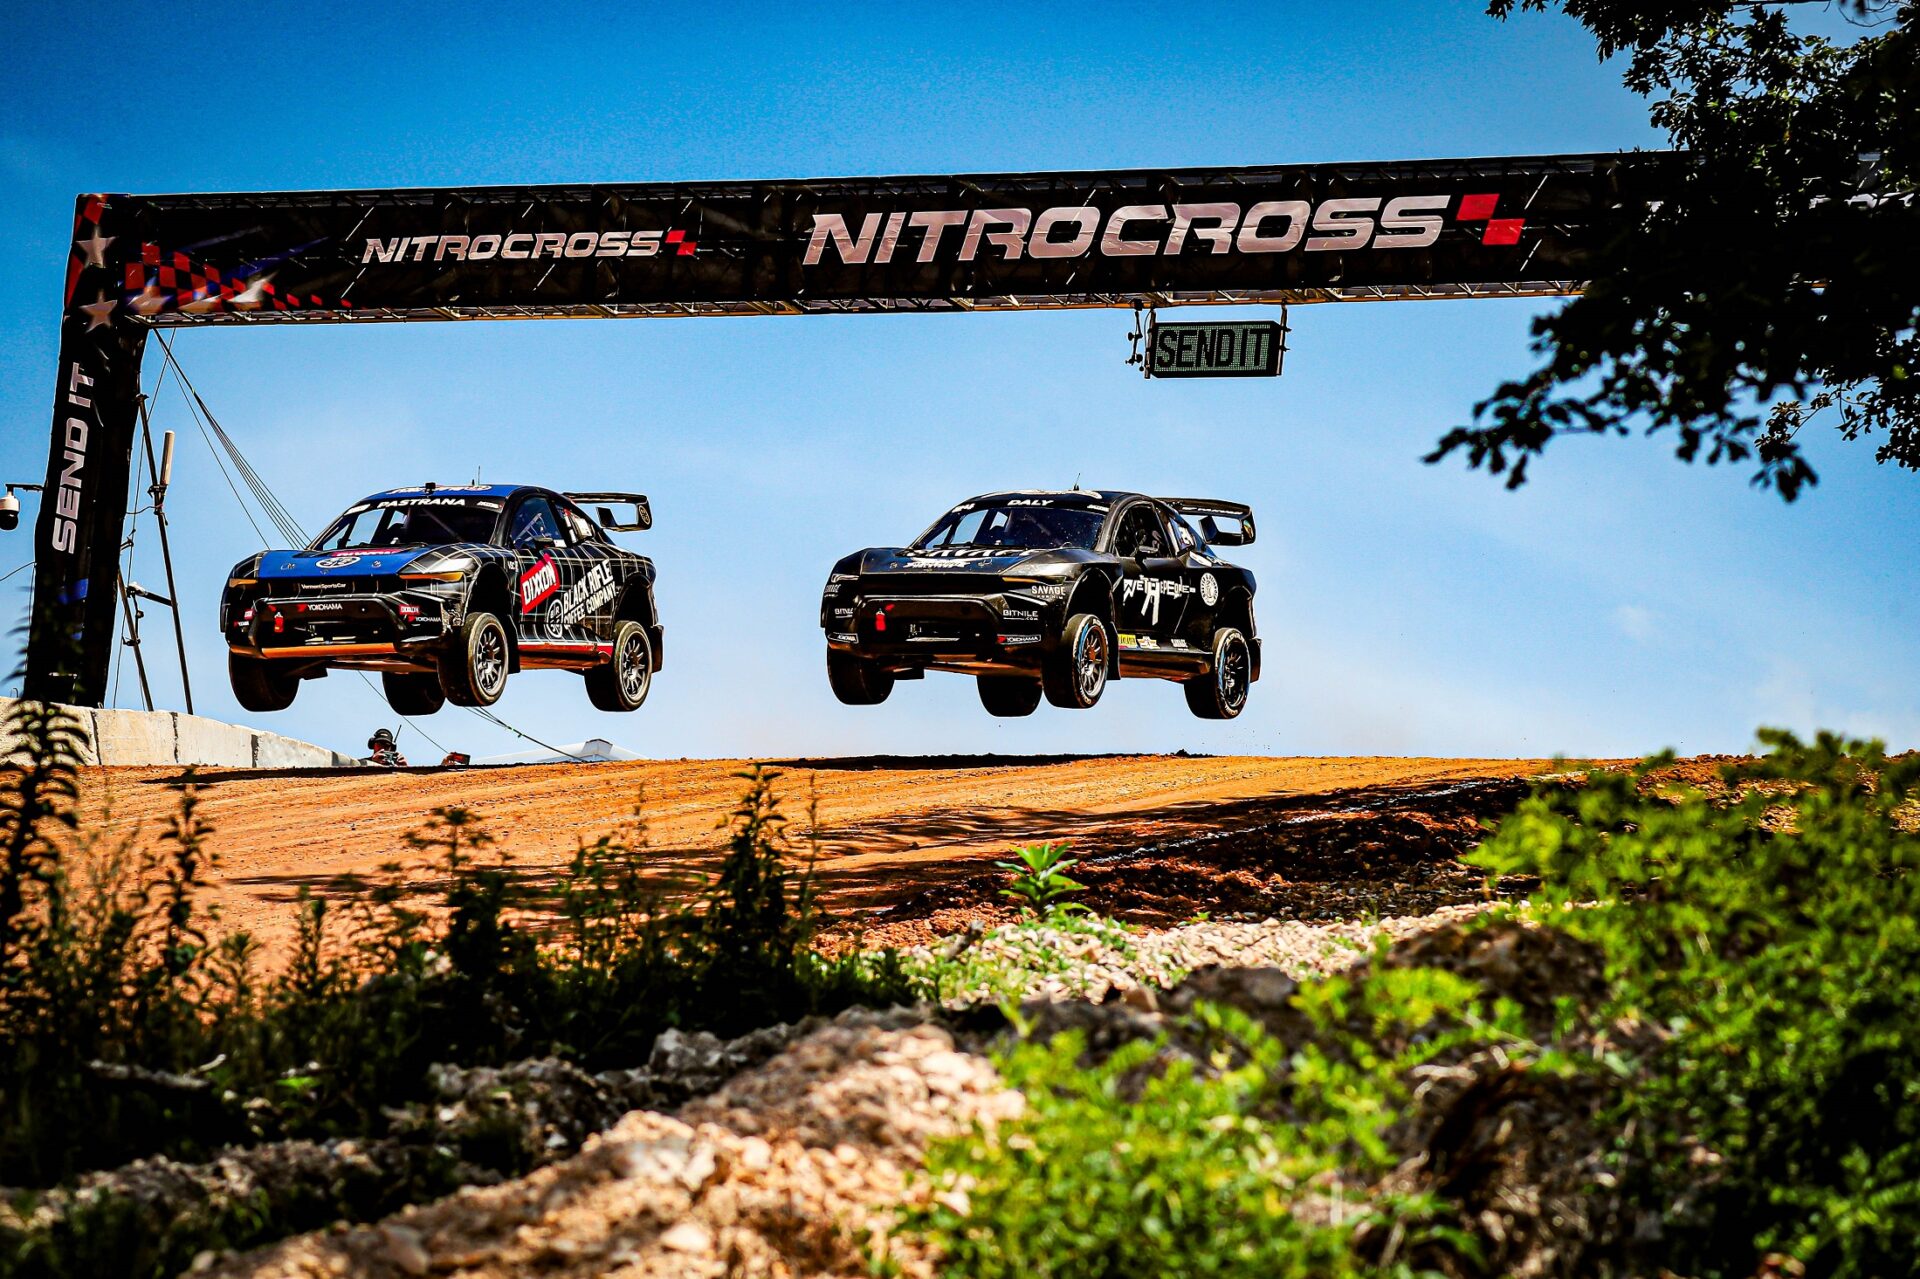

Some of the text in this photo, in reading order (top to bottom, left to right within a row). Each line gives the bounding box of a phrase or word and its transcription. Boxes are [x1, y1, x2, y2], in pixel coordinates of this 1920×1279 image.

[362, 230, 664, 264] NITROCROSS
[803, 194, 1452, 266] NITROCROSS
[52, 362, 95, 555] SEND IT
[376, 498, 466, 508] PASTRANA
[522, 561, 557, 606] DIXXON
[563, 559, 614, 615] BLACK RIFLE
[1031, 585, 1066, 595] SAVAGE
[307, 603, 343, 611] YOKOHAMA
[563, 581, 617, 630] COFFEE COMPANY
[1003, 609, 1039, 617] BITNILE
